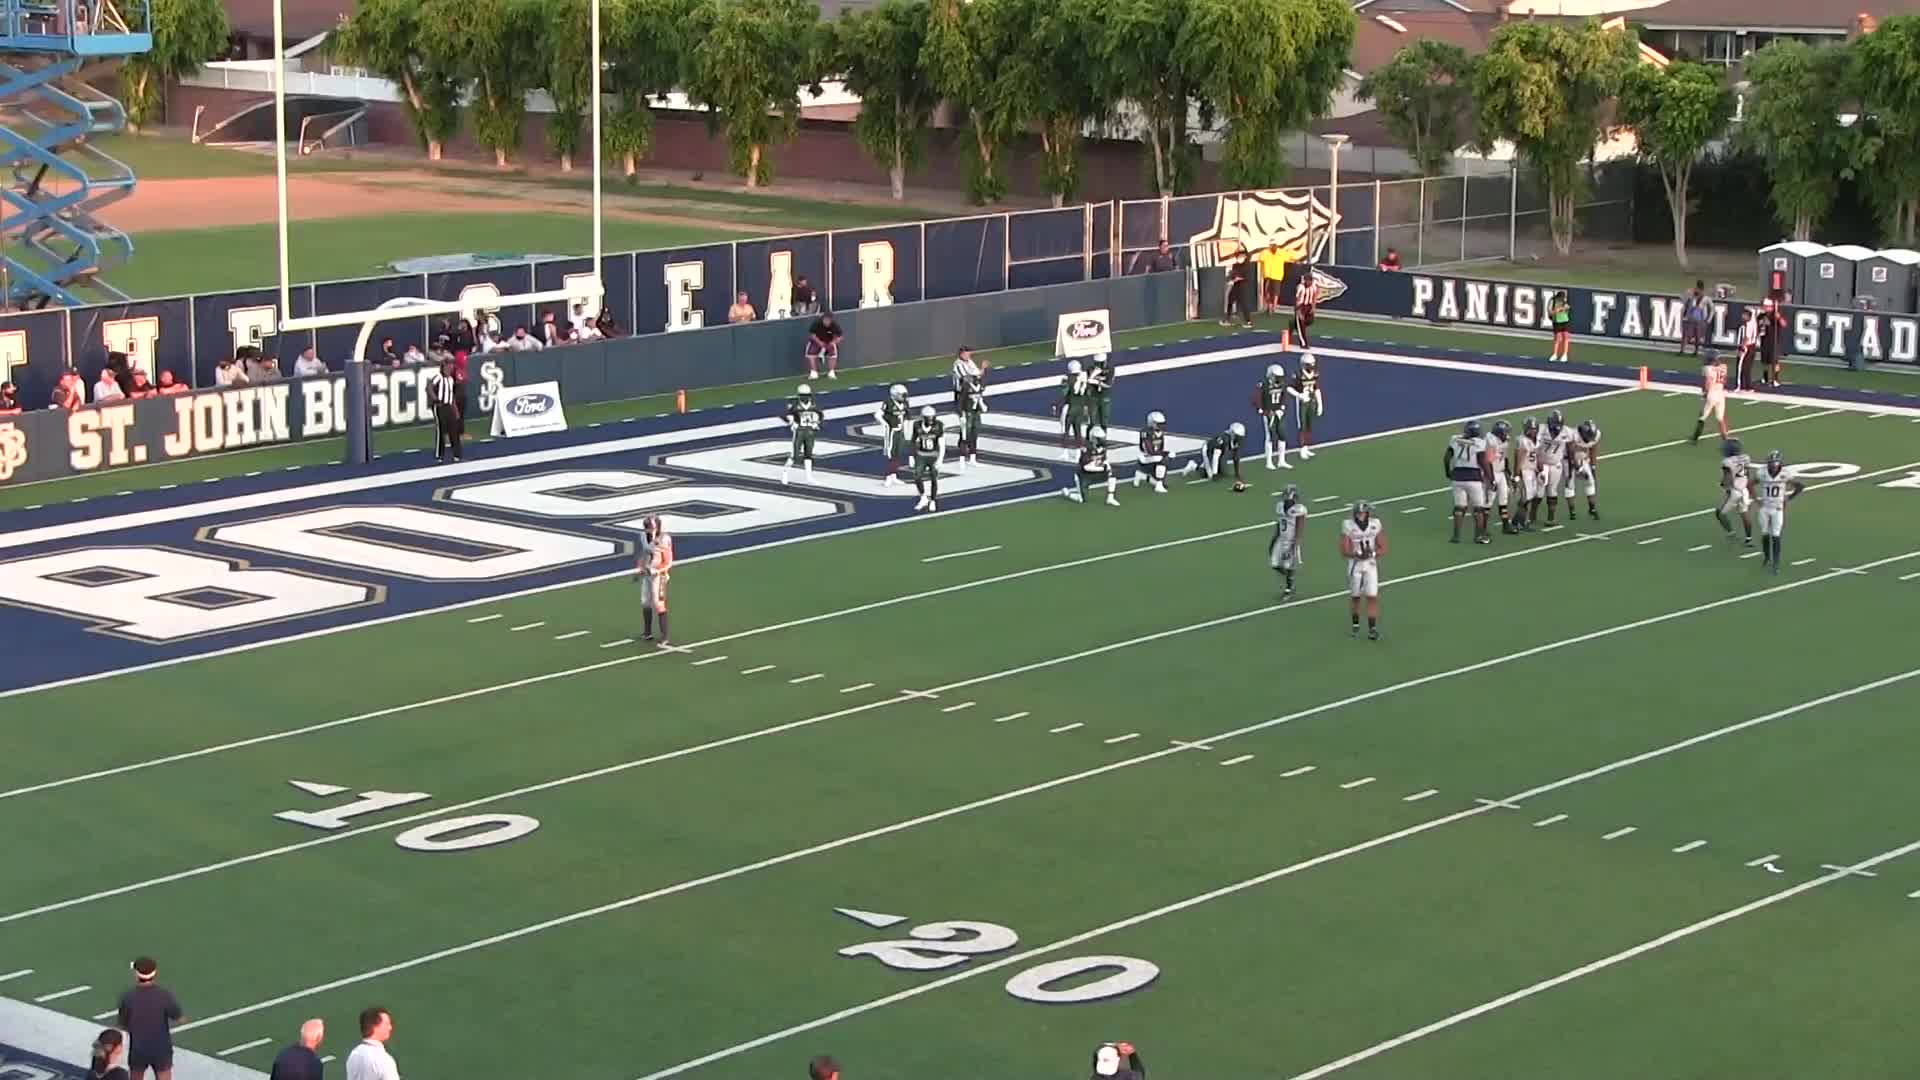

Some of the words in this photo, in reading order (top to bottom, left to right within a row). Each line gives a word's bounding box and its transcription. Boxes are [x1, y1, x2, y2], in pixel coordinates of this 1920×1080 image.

[1072, 321, 1099, 338] Ford
[1591, 292, 1767, 346] FAML
[514, 395, 547, 415] Ford
[68, 404, 147, 470] ST.
[164, 384, 290, 457] JOHN
[1765, 485, 1780, 498] 10
[0, 410, 1213, 645] BOSCO
